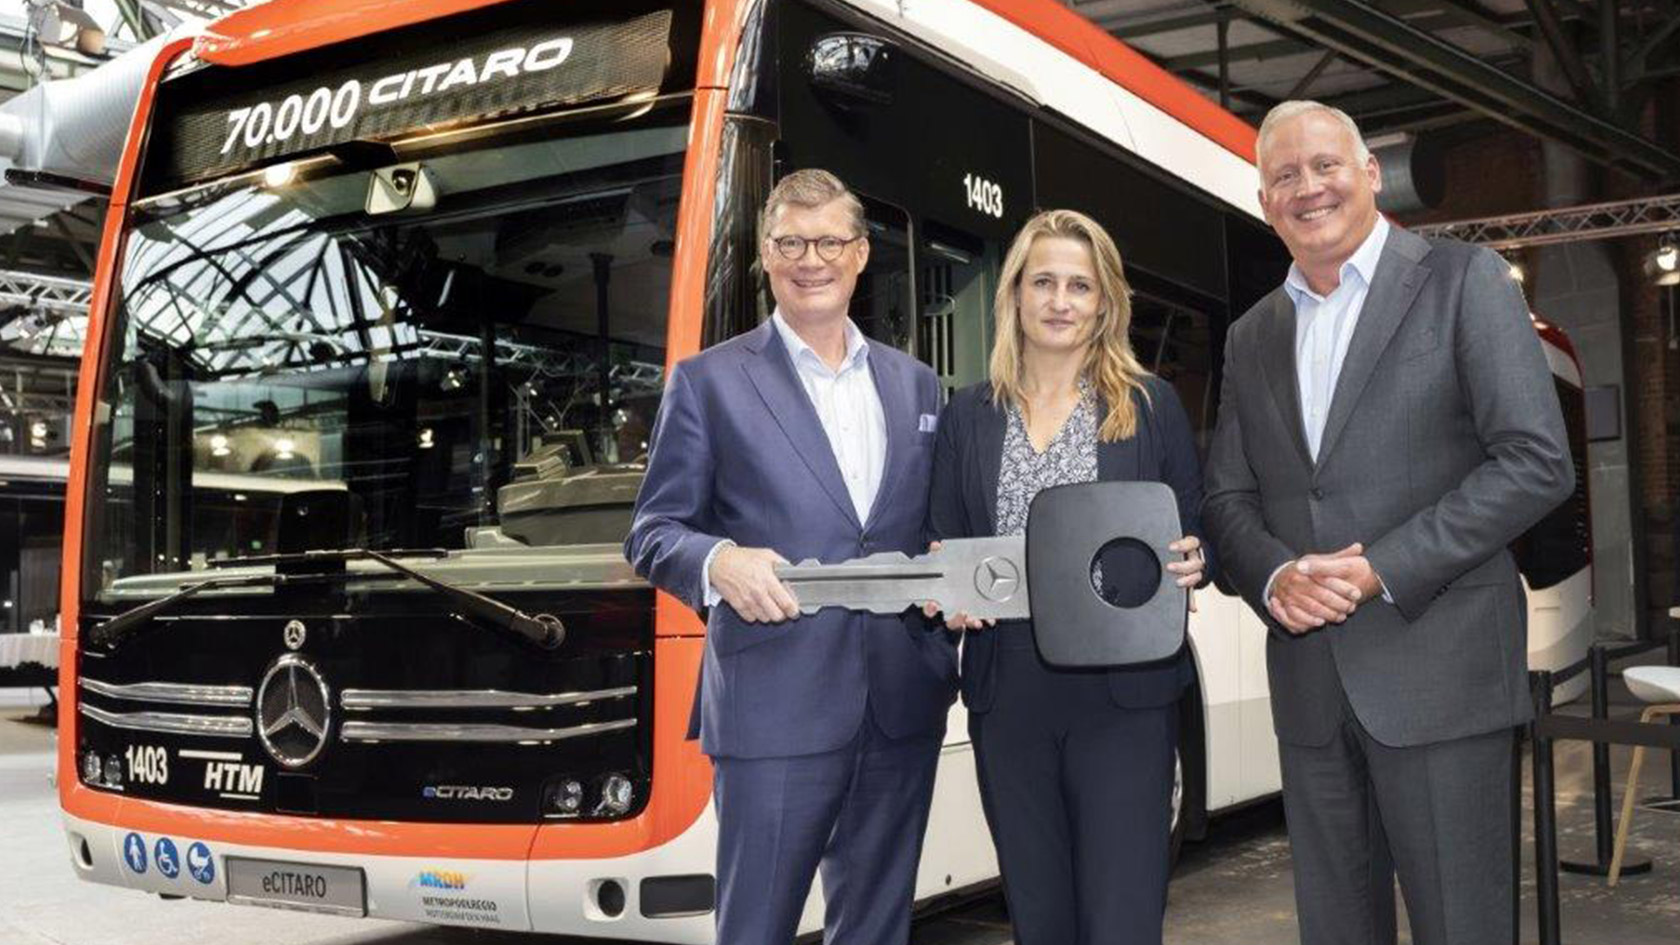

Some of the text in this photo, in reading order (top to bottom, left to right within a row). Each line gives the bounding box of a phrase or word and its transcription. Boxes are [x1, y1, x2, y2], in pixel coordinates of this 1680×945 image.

[220, 37, 574, 154] 70.000 CITARO
[963, 173, 1003, 218] 1403
[125, 744, 168, 785] 1403
[204, 762, 264, 793] HTM
[262, 871, 327, 898] eCITARO
